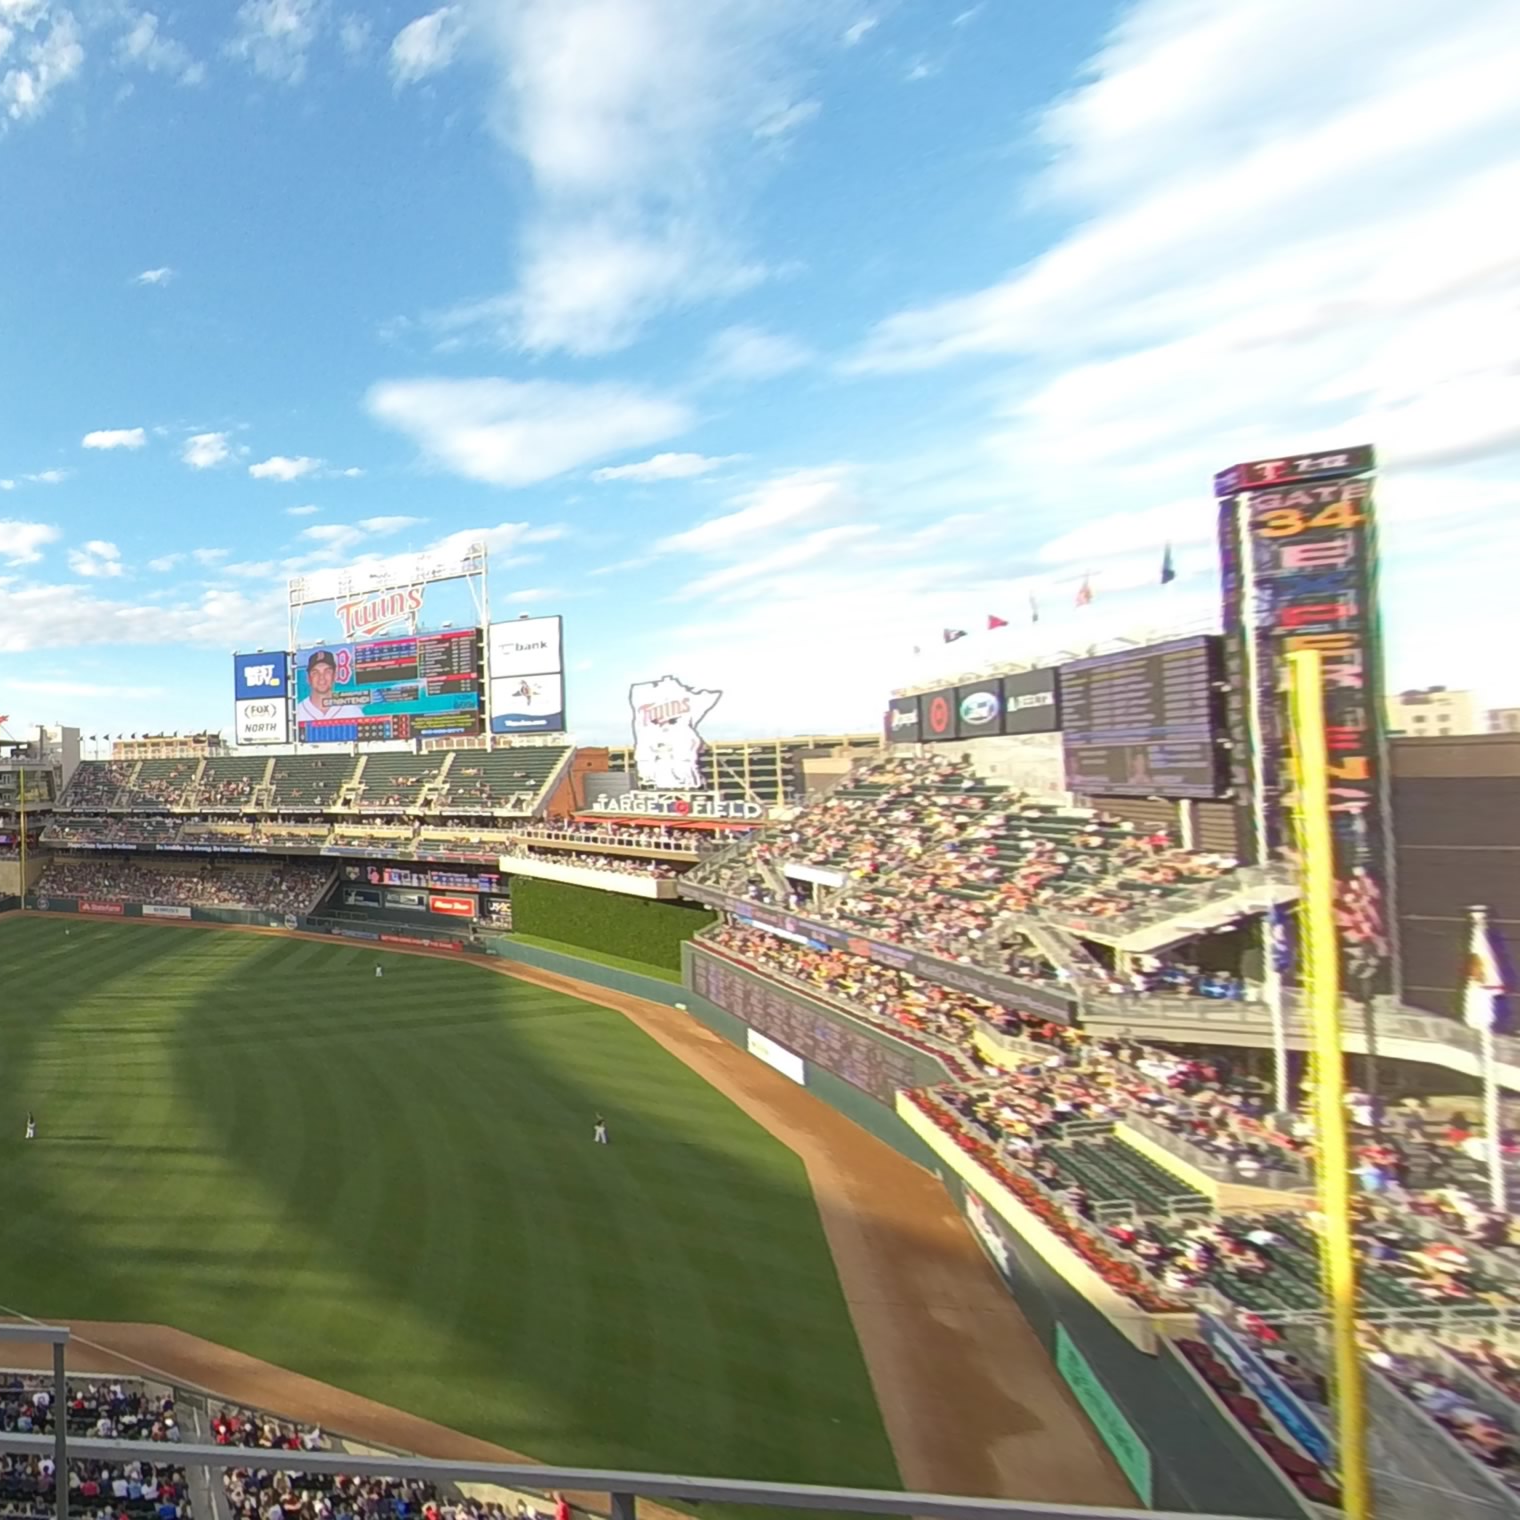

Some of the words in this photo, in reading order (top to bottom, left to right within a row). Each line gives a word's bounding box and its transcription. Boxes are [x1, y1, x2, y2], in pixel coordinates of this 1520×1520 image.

[1250, 481, 1369, 511] GATE
[1258, 501, 1371, 538] 34
[337, 588, 422, 635] Twins
[515, 640, 549, 652] bank
[251, 704, 270, 714] FOX
[637, 697, 691, 727] Twins
[245, 723, 277, 733] NORTH
[594, 798, 671, 814] TARGET
[692, 800, 762, 819] FIELD
